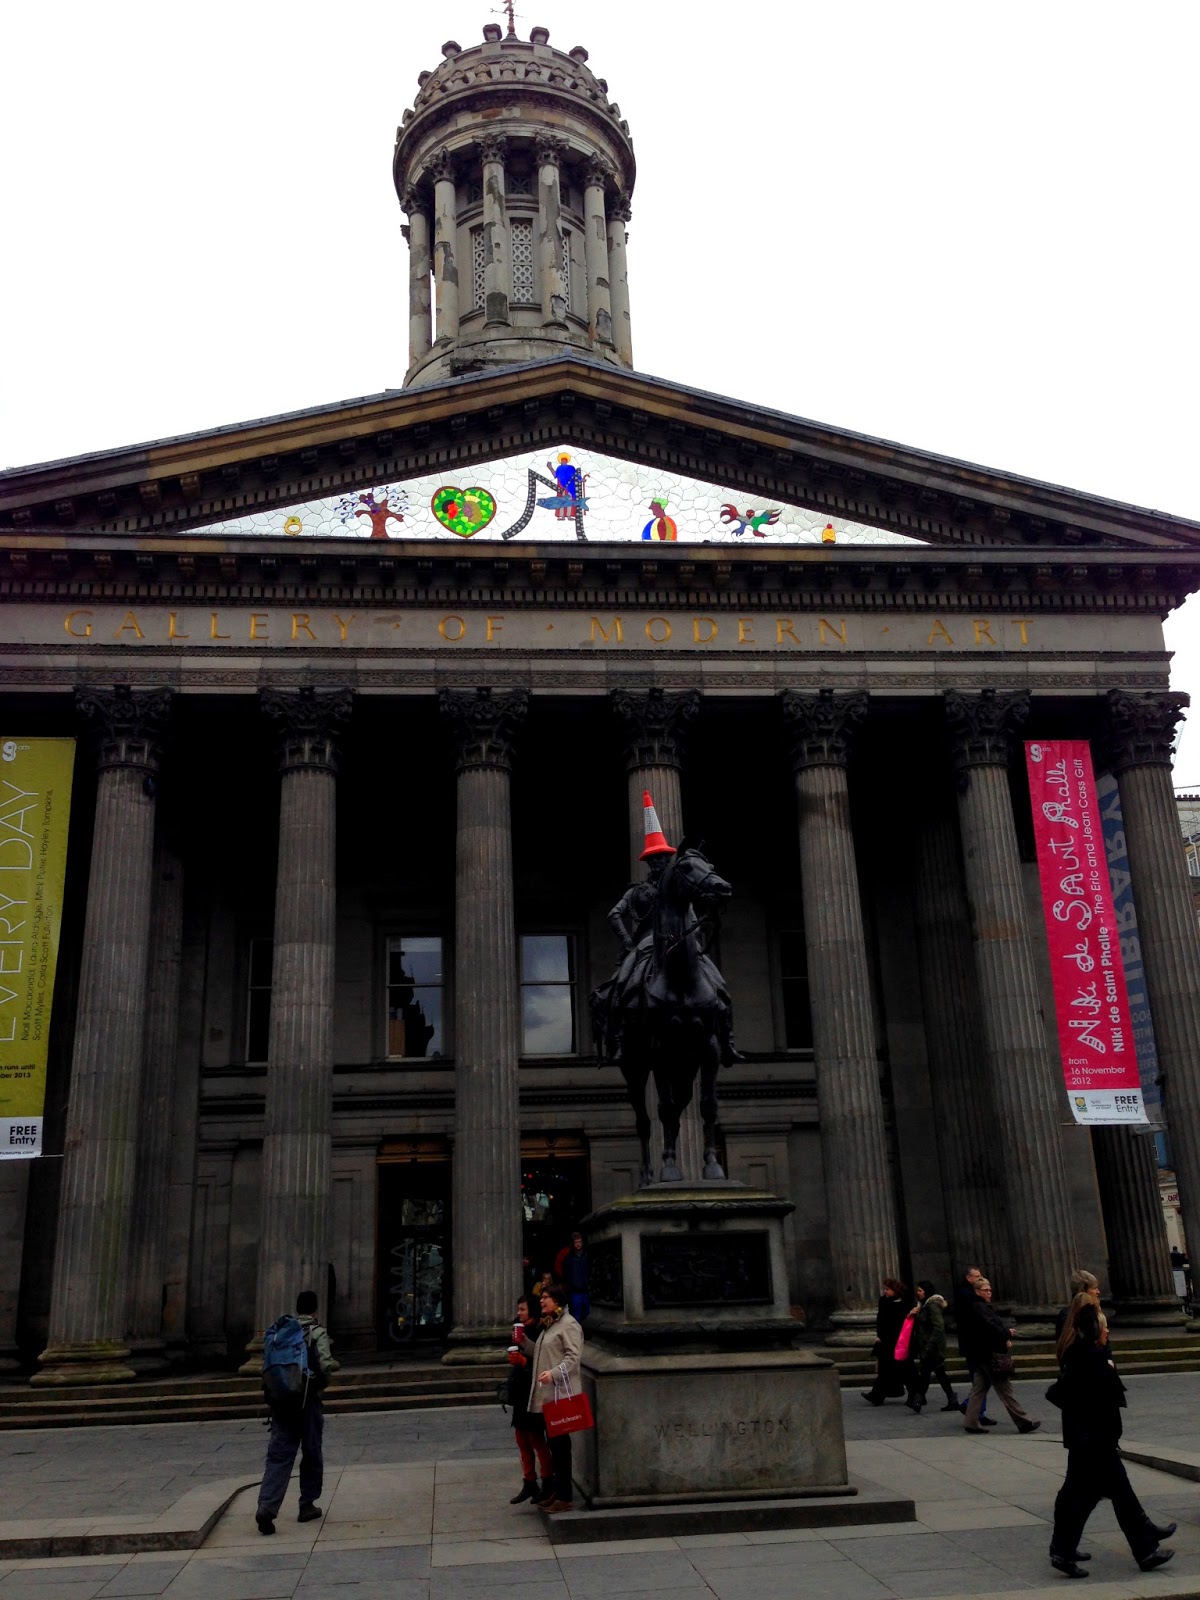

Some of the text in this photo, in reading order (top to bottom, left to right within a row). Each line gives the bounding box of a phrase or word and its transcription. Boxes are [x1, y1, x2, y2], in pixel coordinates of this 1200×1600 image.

[63, 610, 1035, 646] GALLERY OF MODERN ART
[1073, 758, 1084, 778] Gift
[1042, 758, 1079, 829] Phalle
[1076, 781, 1088, 808] Cass
[0, 779, 39, 870] DAY
[1080, 811, 1092, 840] Jean
[1085, 843, 1097, 868] and
[1089, 870, 1101, 891] Eric
[1093, 894, 1105, 914] The
[43, 905, 53, 939] Fullerton
[21, 1022, 30, 1041] Niall
[28, 942, 38, 966] Laura
[35, 881, 44, 900] Mick
[40, 828, 51, 856] Hayley
[40, 941, 49, 962] Scott
[1063, 937, 1095, 972] de
[1098, 927, 1113, 967] Phalle
[37, 965, 47, 989] Carla
[1103, 970, 1117, 1003] Saint
[1068, 981, 1106, 1054] Niki
[1108, 1006, 1121, 1024] de
[33, 1018, 42, 1041] Scott
[1110, 1027, 1125, 1053] Niki
[1071, 1066, 1126, 1075] 16 November
[1071, 1077, 1092, 1085] 2012
[1114, 1095, 1138, 1104] FREE
[1116, 1104, 1139, 1113] Entry
[9, 1136, 36, 1145] Entry
[10, 1125, 37, 1136] FREE
[654, 1419, 790, 1439] WELLINGTON
